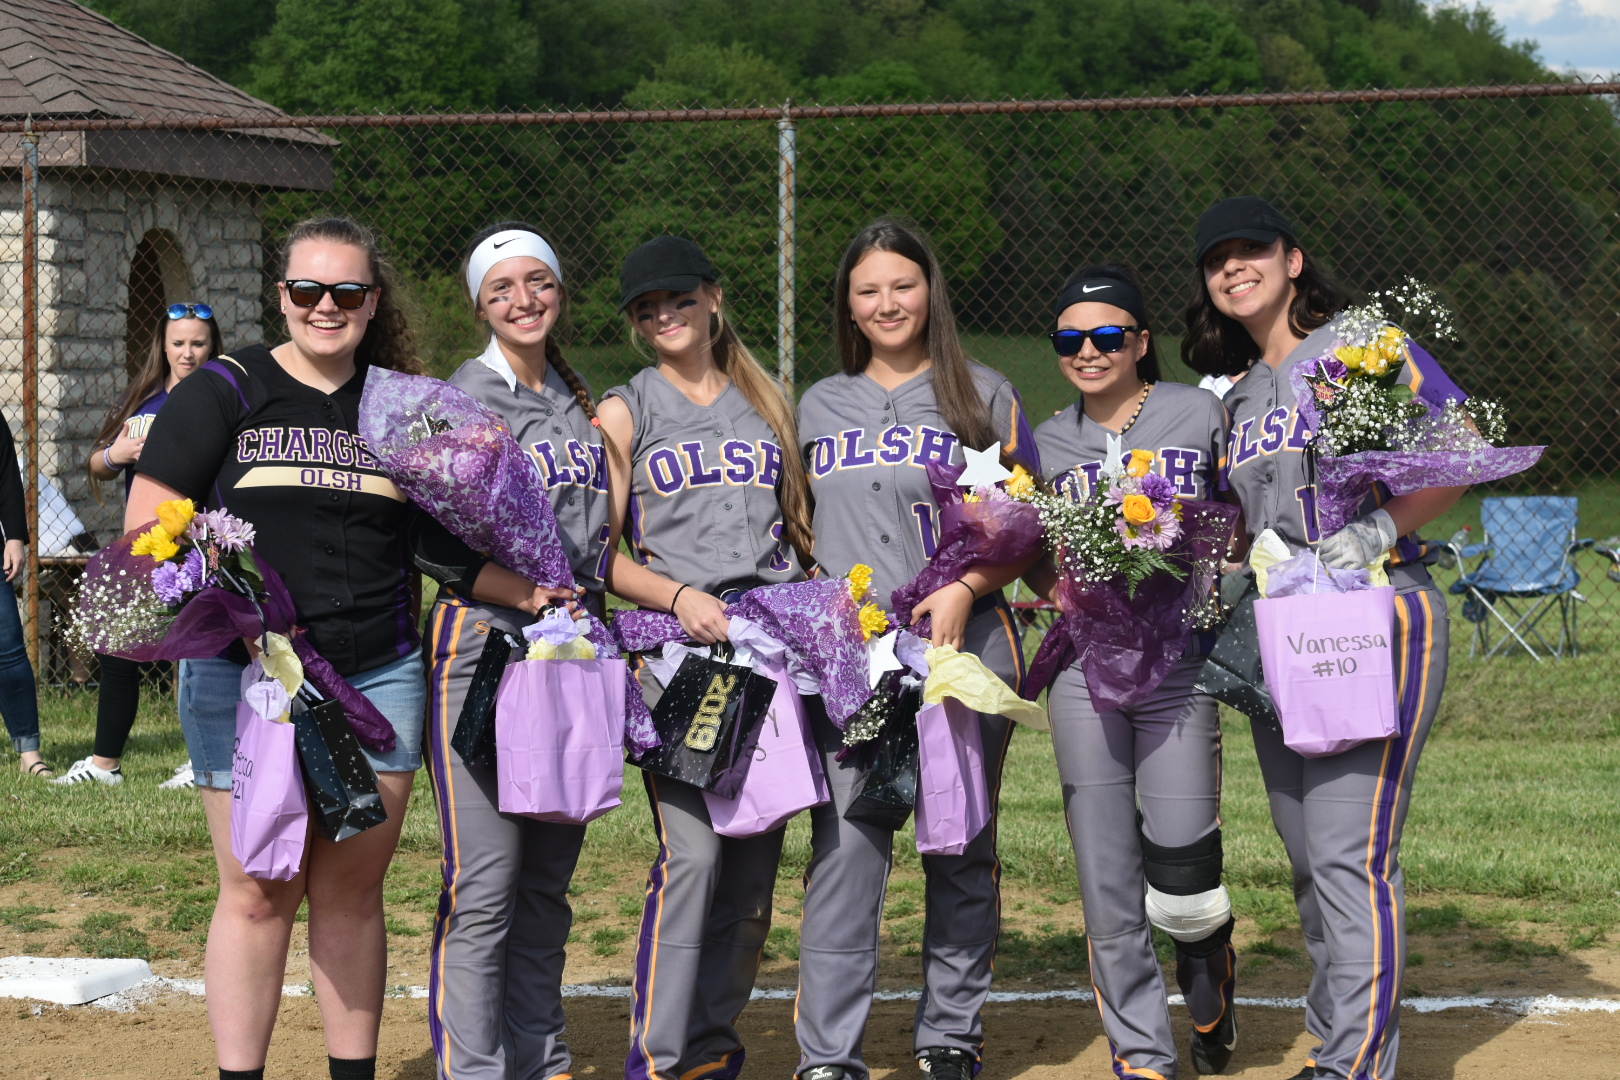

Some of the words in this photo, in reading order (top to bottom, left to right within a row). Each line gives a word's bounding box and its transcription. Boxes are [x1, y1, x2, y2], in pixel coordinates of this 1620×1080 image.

[237, 427, 379, 470] CHARGE
[522, 439, 608, 494] LSH
[813, 425, 959, 479] OLSH
[300, 468, 362, 490] OLSH
[1287, 632, 1387, 655] Vanessa
[1311, 657, 1358, 677] #10
[684, 673, 737, 751] 2019
